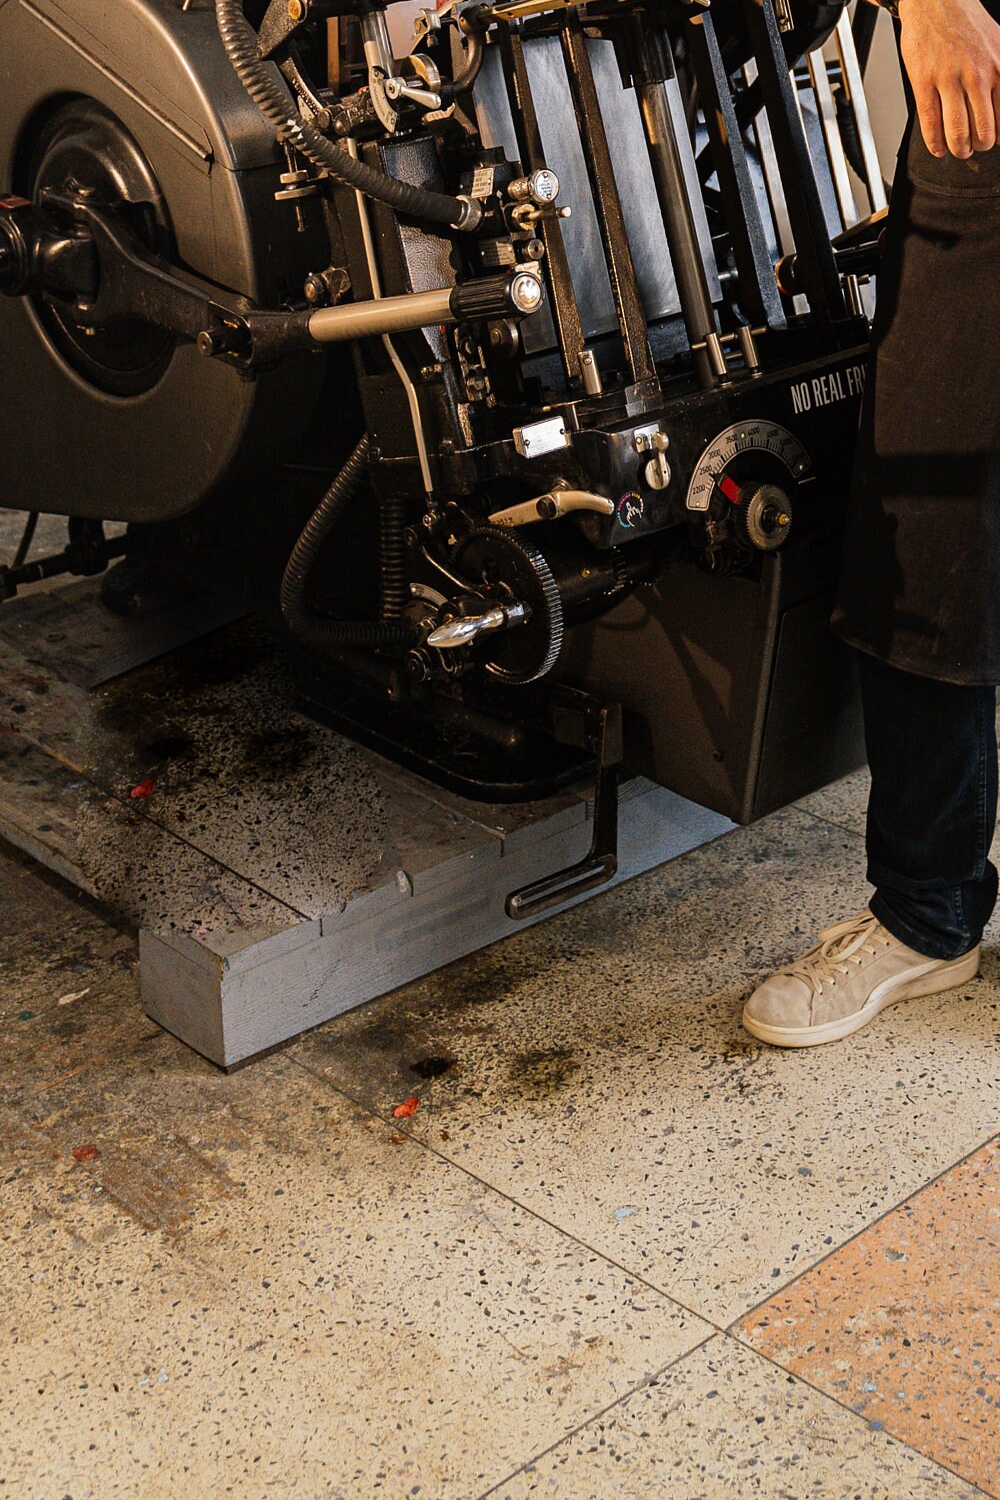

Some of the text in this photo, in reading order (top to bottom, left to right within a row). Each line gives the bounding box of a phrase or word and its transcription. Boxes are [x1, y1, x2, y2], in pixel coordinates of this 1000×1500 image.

[790, 362, 867, 414] NO REAL FRI
[748, 426, 760, 436] 4000
[725, 434, 738, 444] 3500
[699, 465, 713, 475] 2500
[692, 485, 706, 495] 2200
